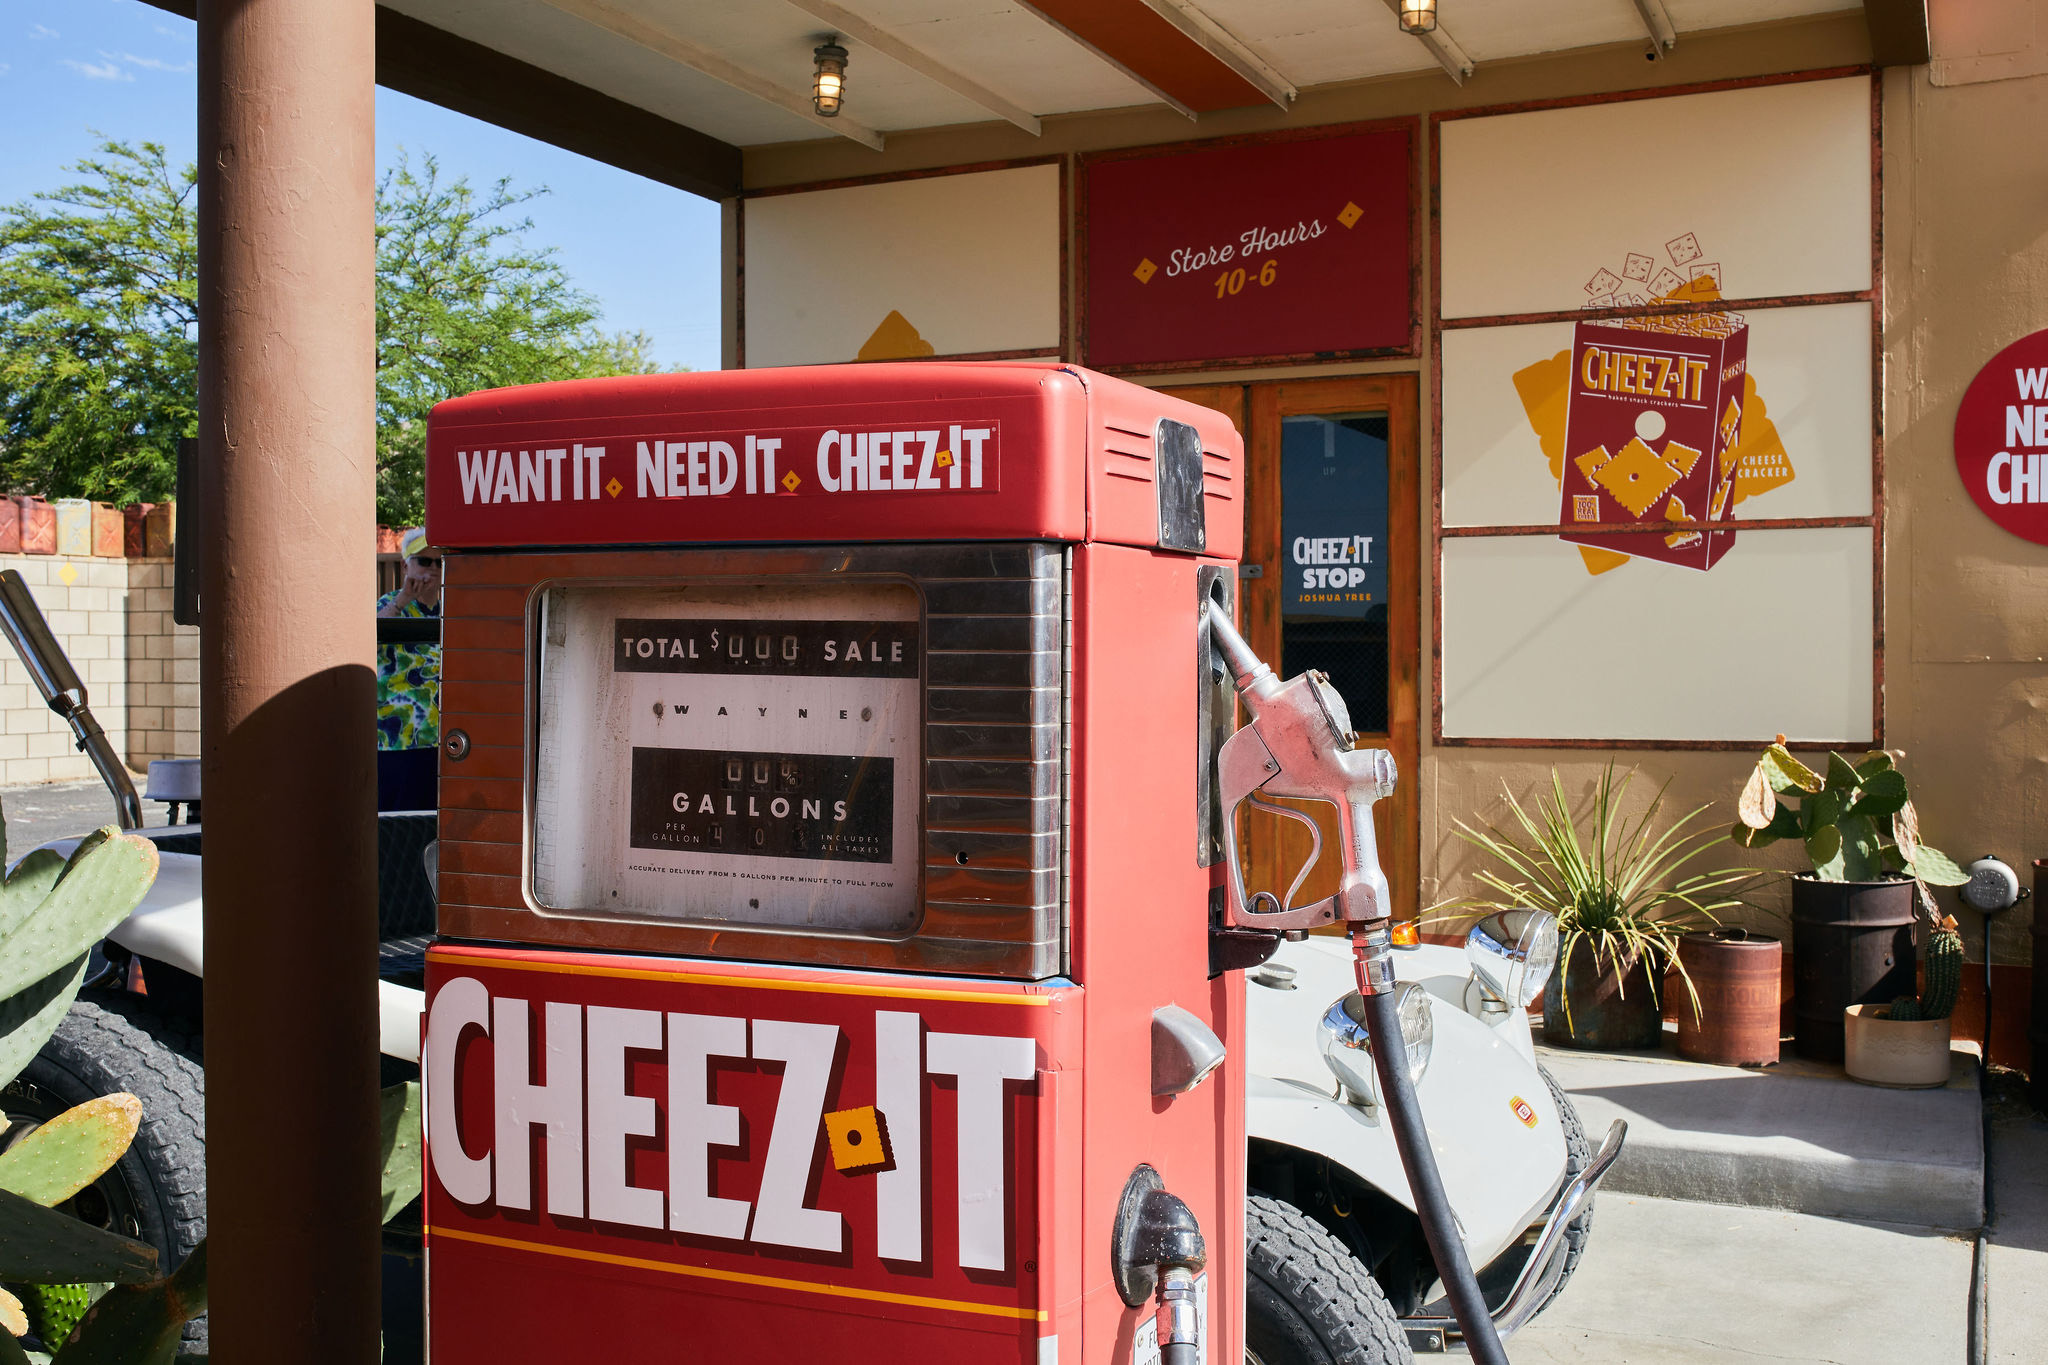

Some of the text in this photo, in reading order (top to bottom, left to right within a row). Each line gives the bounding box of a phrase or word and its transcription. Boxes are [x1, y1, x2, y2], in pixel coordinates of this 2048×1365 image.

[1166, 219, 1328, 277] Store Hours
[1213, 259, 1279, 299] 10-6
[1742, 454, 1783, 466] CHEESE
[457, 448, 566, 505] WANT
[636, 440, 738, 498] NEED
[1737, 466, 1788, 478] CRACKER
[1303, 567, 1366, 589] STOP
[1299, 592, 1372, 602] JOSHUA TREE
[622, 637, 699, 660] TOTAL
[823, 640, 903, 662] SALE
[674, 704, 848, 720] WAYNE
[672, 792, 847, 821] GALLONS
[665, 822, 686, 832] PER
[652, 832, 700, 844] GALLON
[821, 834, 880, 843] INCLUDES
[821, 844, 880, 854] ALL TAXES
[628, 865, 666, 873] ACCURATE
[669, 868, 705, 876] DELIVERY
[740, 872, 777, 881] GALLONS
[798, 876, 828, 884] MINUTE
